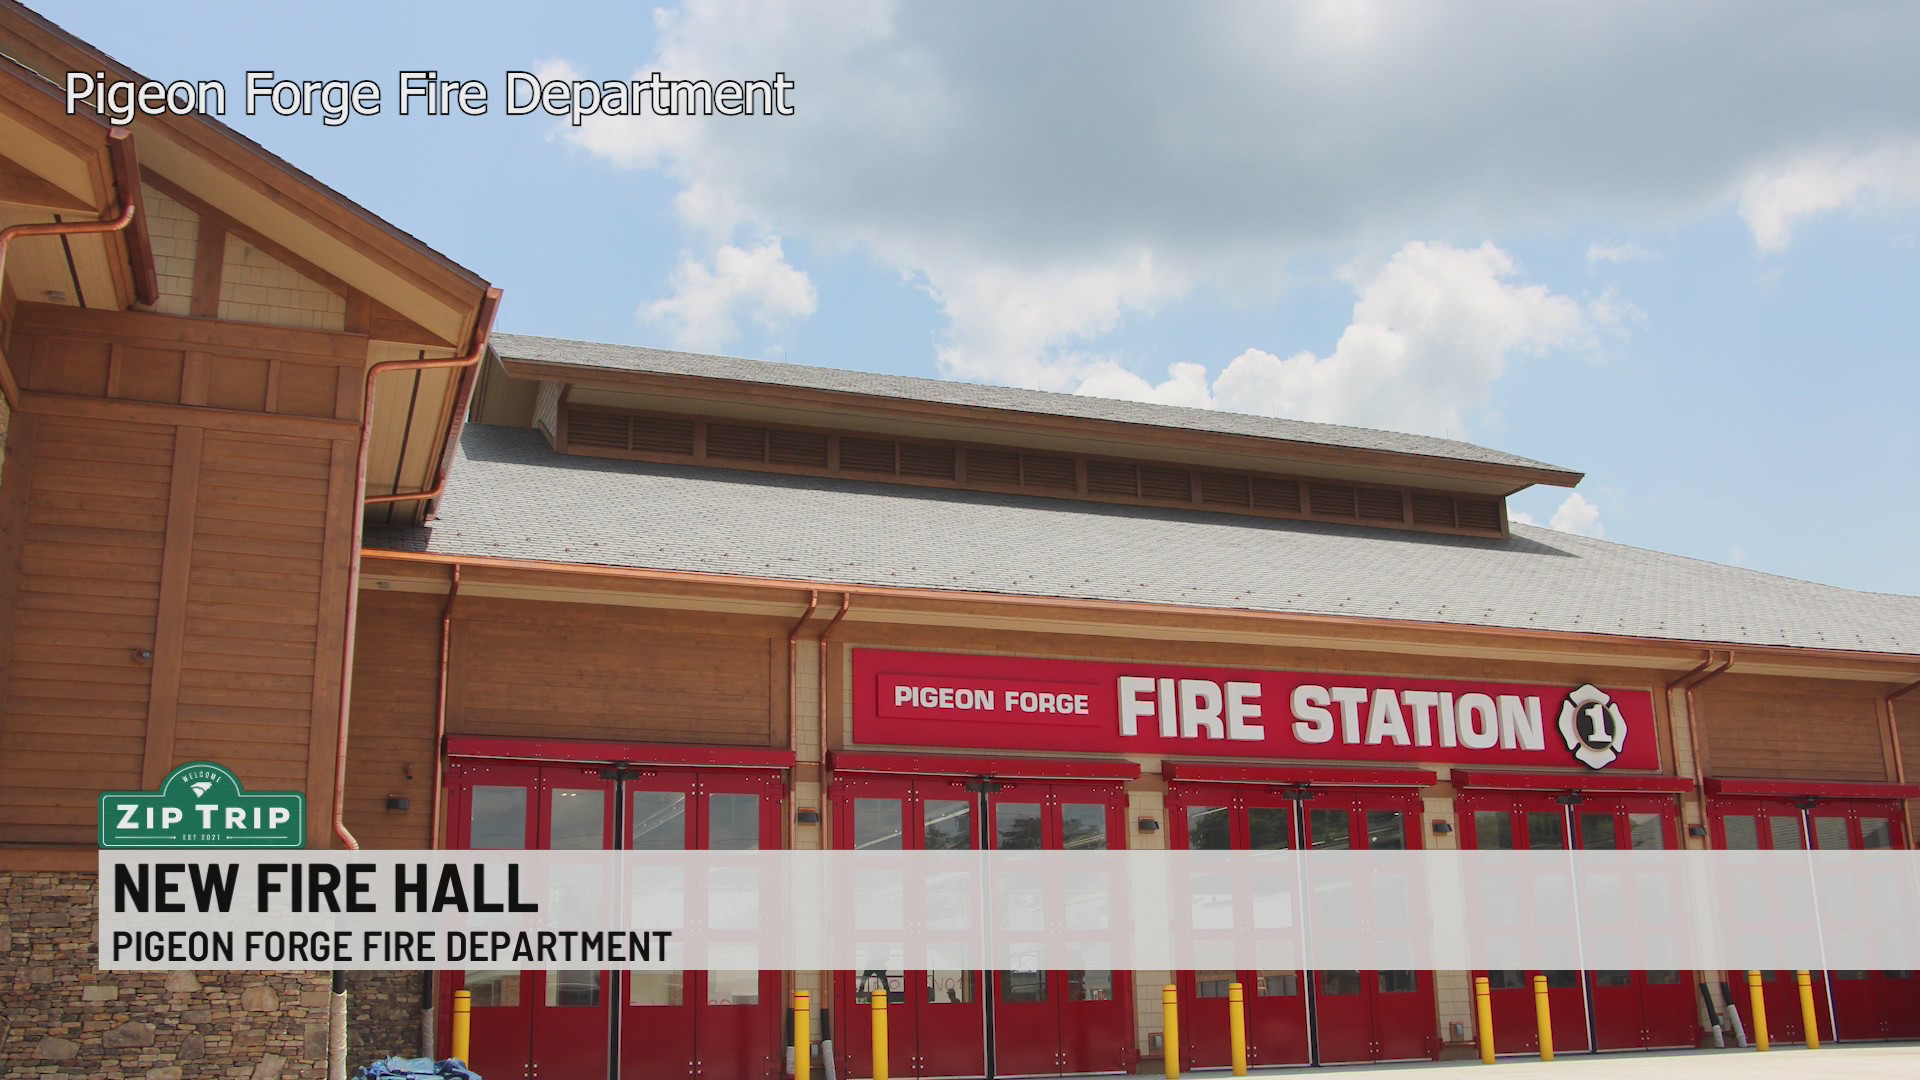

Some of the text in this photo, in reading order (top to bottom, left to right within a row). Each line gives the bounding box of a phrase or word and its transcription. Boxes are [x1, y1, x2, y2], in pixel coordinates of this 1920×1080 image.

[894, 685, 1090, 715] PIGEON FORGE
[1117, 676, 1613, 751] FIRE STATION 1
